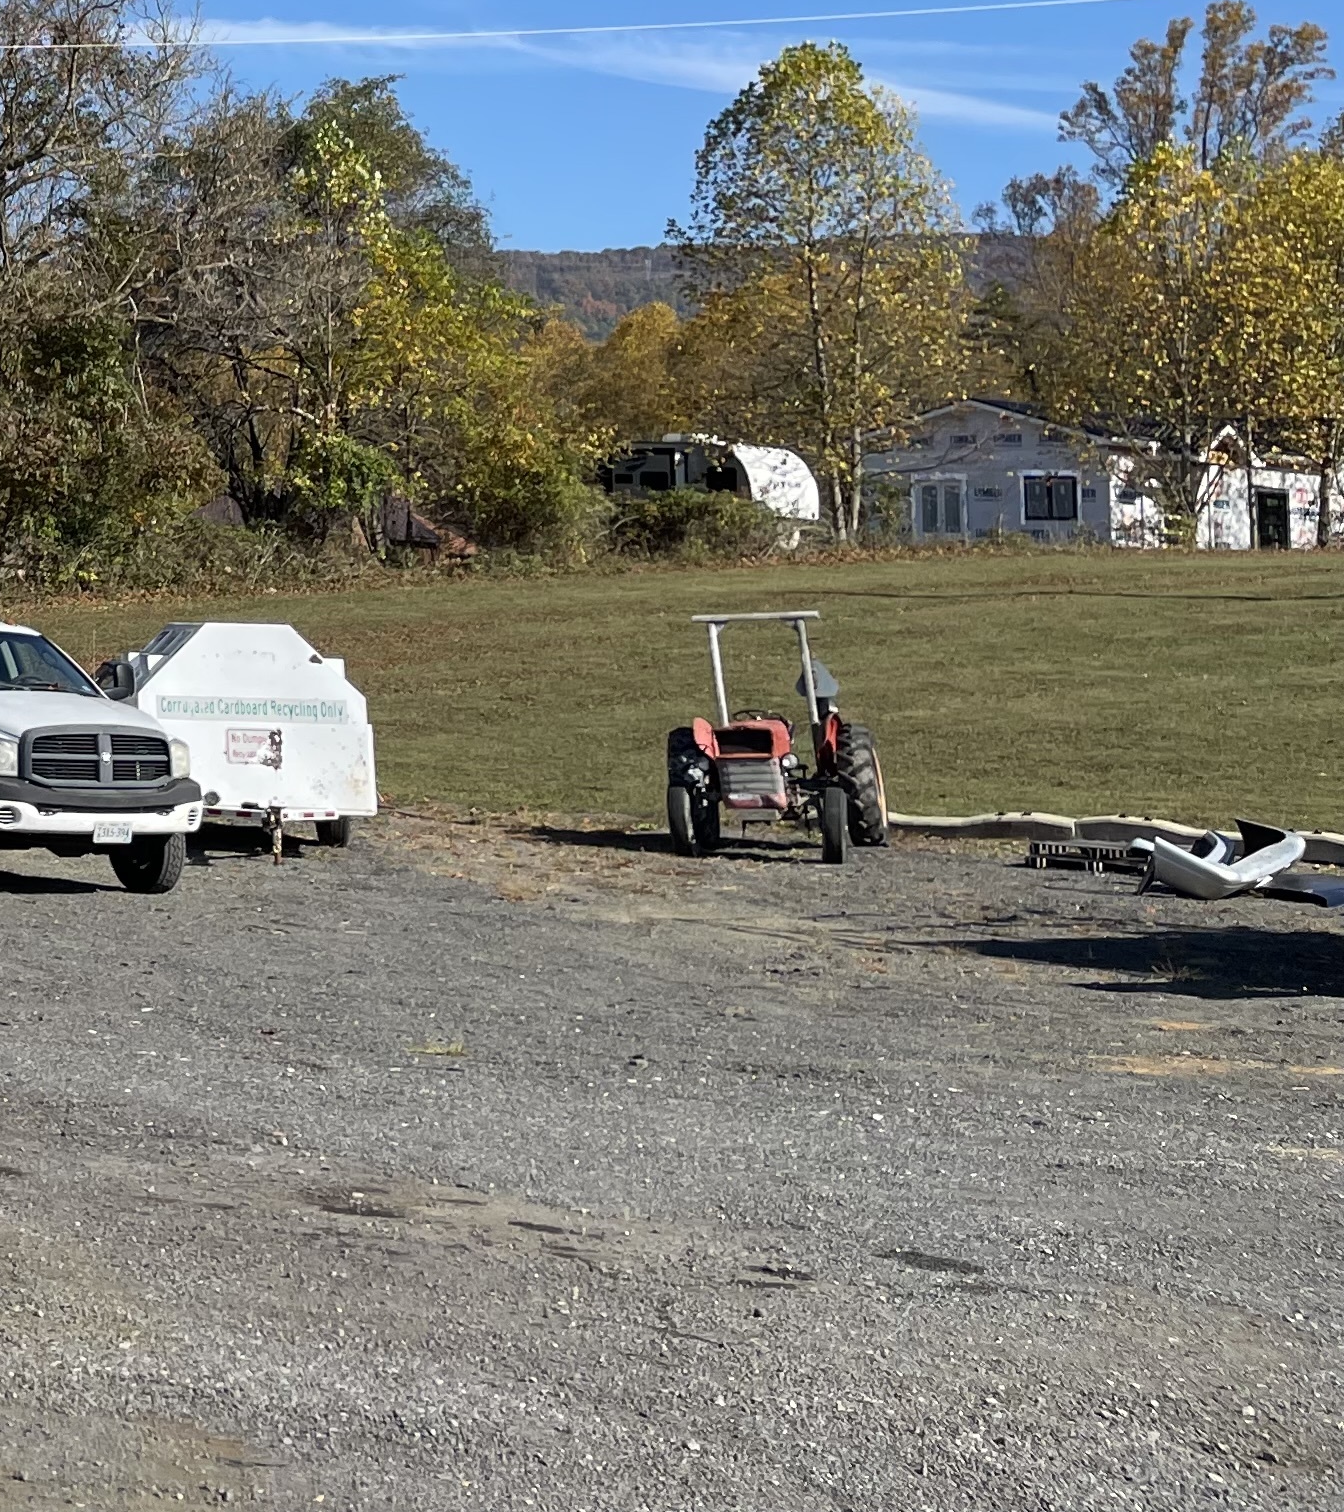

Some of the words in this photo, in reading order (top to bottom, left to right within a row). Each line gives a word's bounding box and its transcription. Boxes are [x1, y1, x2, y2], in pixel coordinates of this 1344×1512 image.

[218, 698, 268, 716] Cardboard
[270, 699, 318, 722] Recycling
[320, 701, 344, 723] Only
